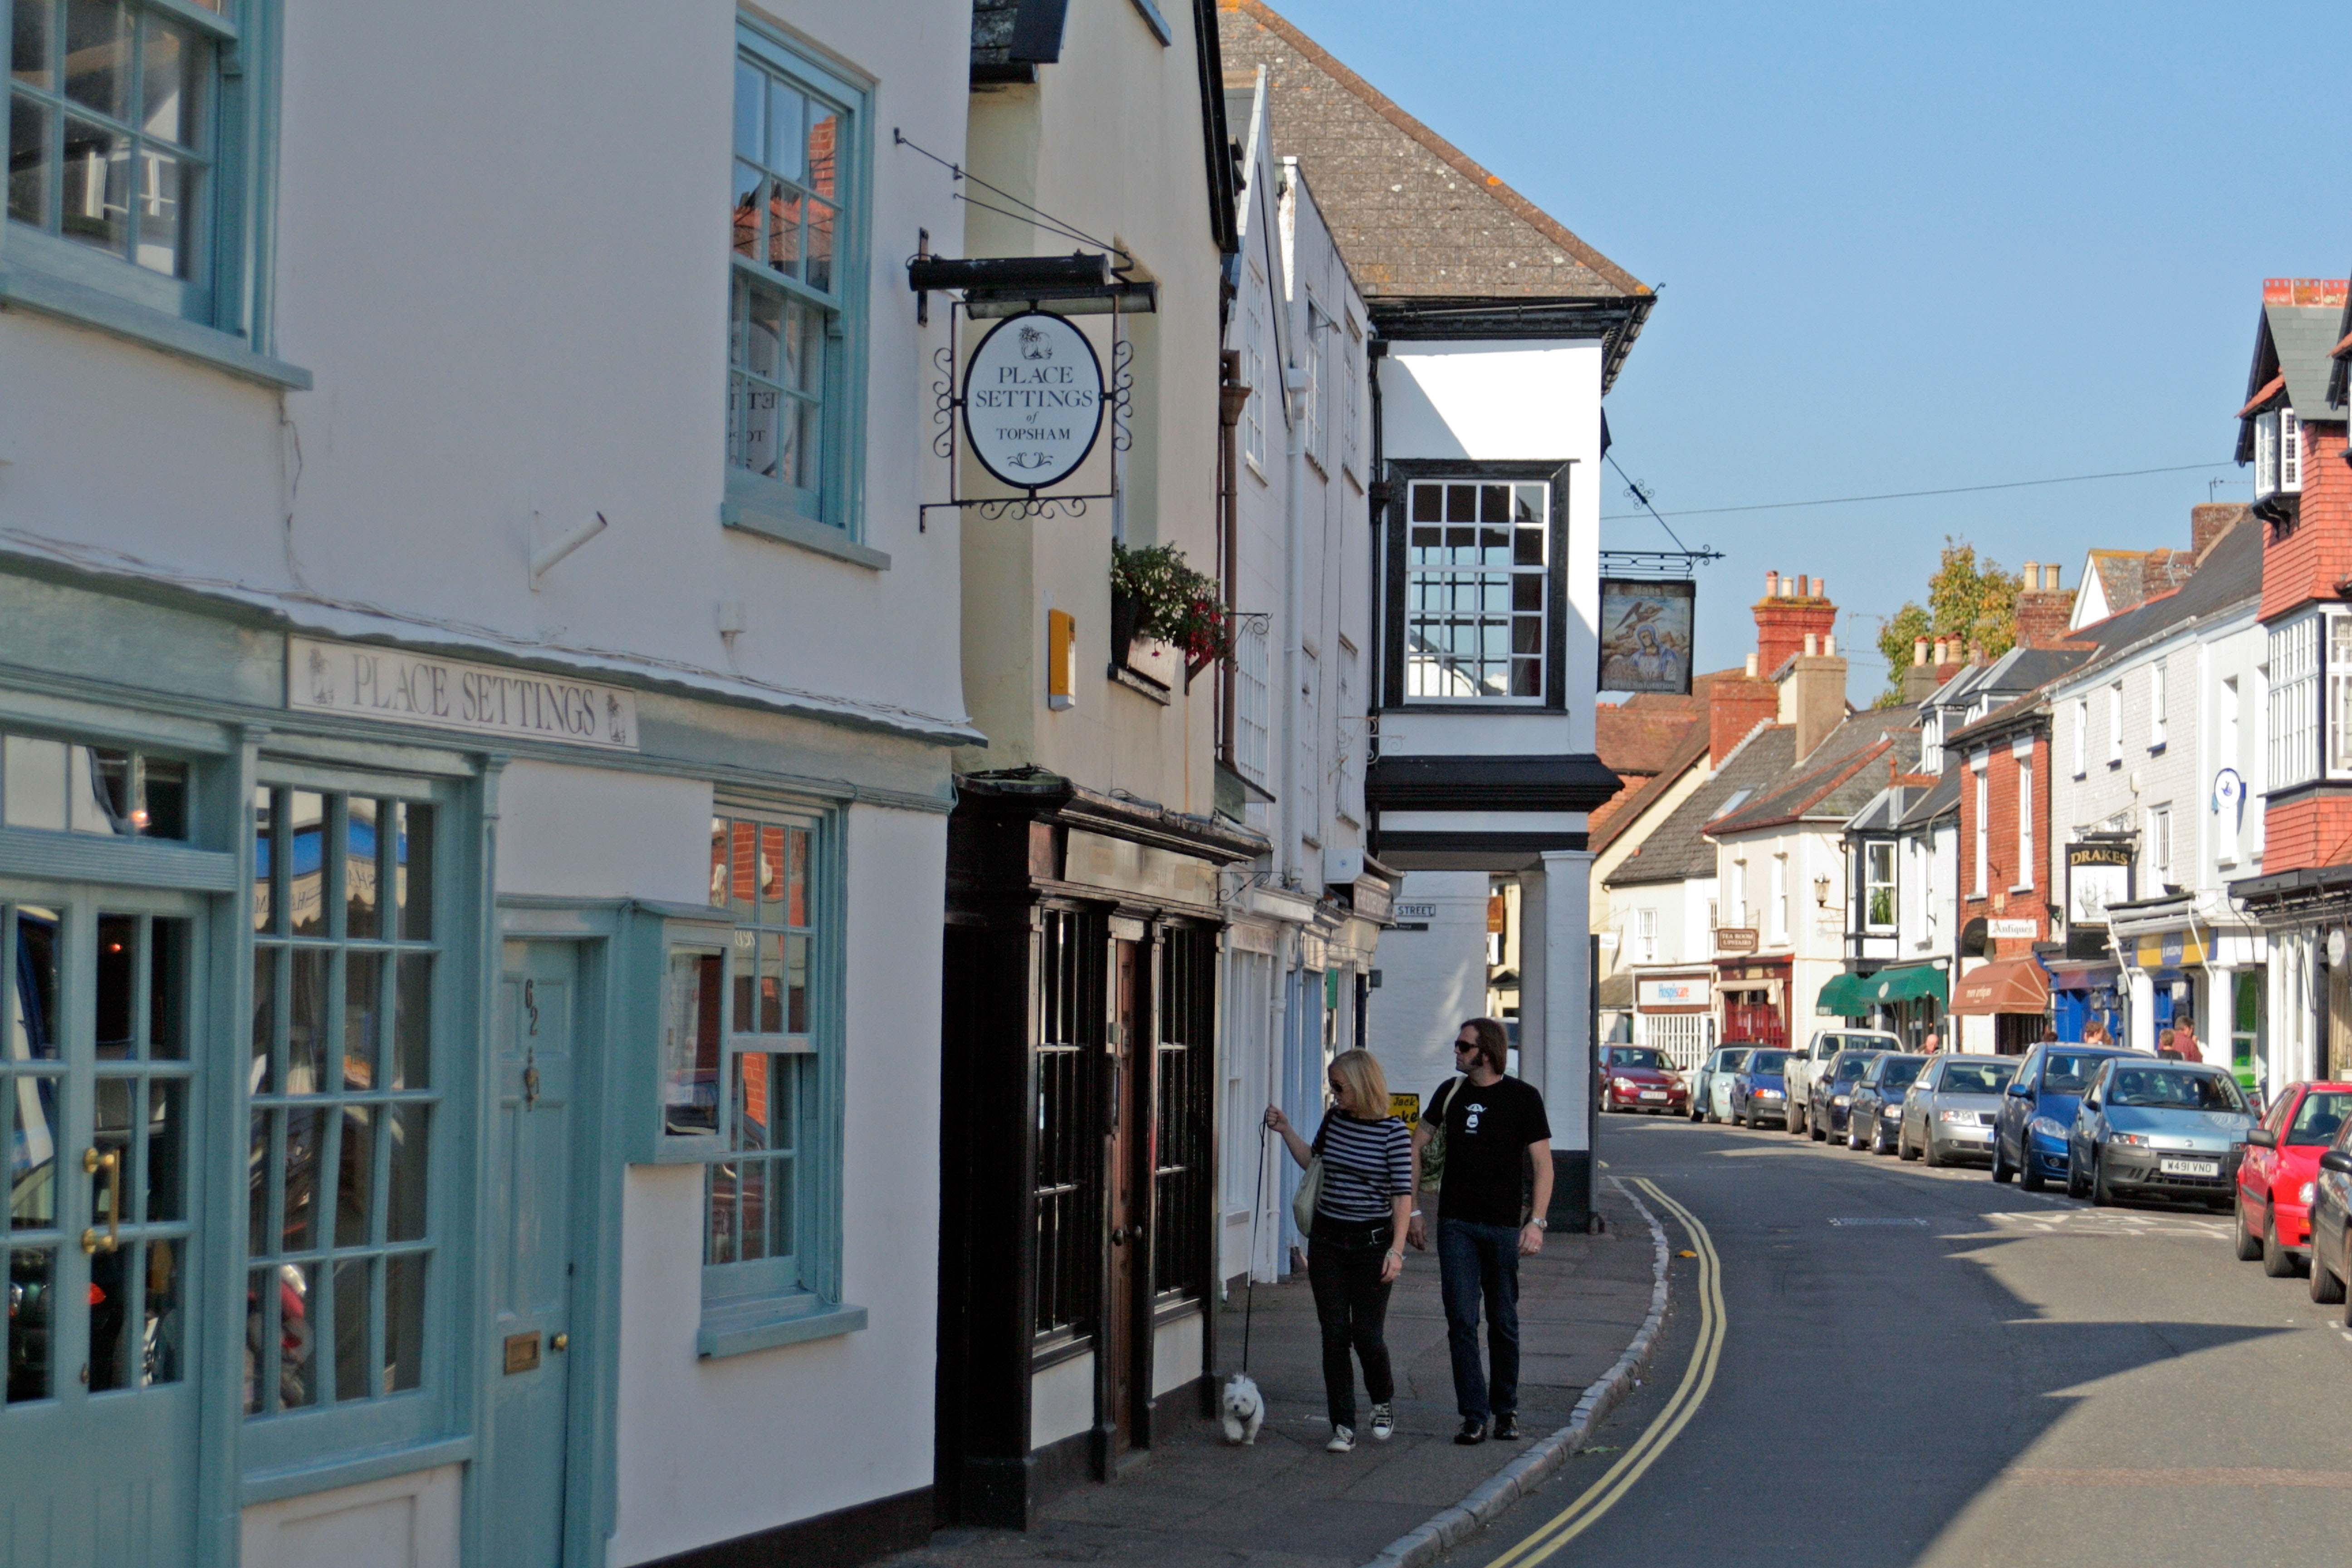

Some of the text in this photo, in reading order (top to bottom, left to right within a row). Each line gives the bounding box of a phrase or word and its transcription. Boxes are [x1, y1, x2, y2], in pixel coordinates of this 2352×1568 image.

[999, 367, 1073, 384] PLACE
[976, 390, 1093, 407] SETTINGS
[1026, 412, 1038, 424] of
[996, 428, 1070, 440] TOPSHAM
[353, 654, 596, 736] PLACE SETTINGS
[2070, 849, 2128, 865] DRAKES
[1398, 906, 1432, 915] STREET
[1992, 920, 2033, 935] Antiques
[2168, 1161, 2190, 1171] W491
